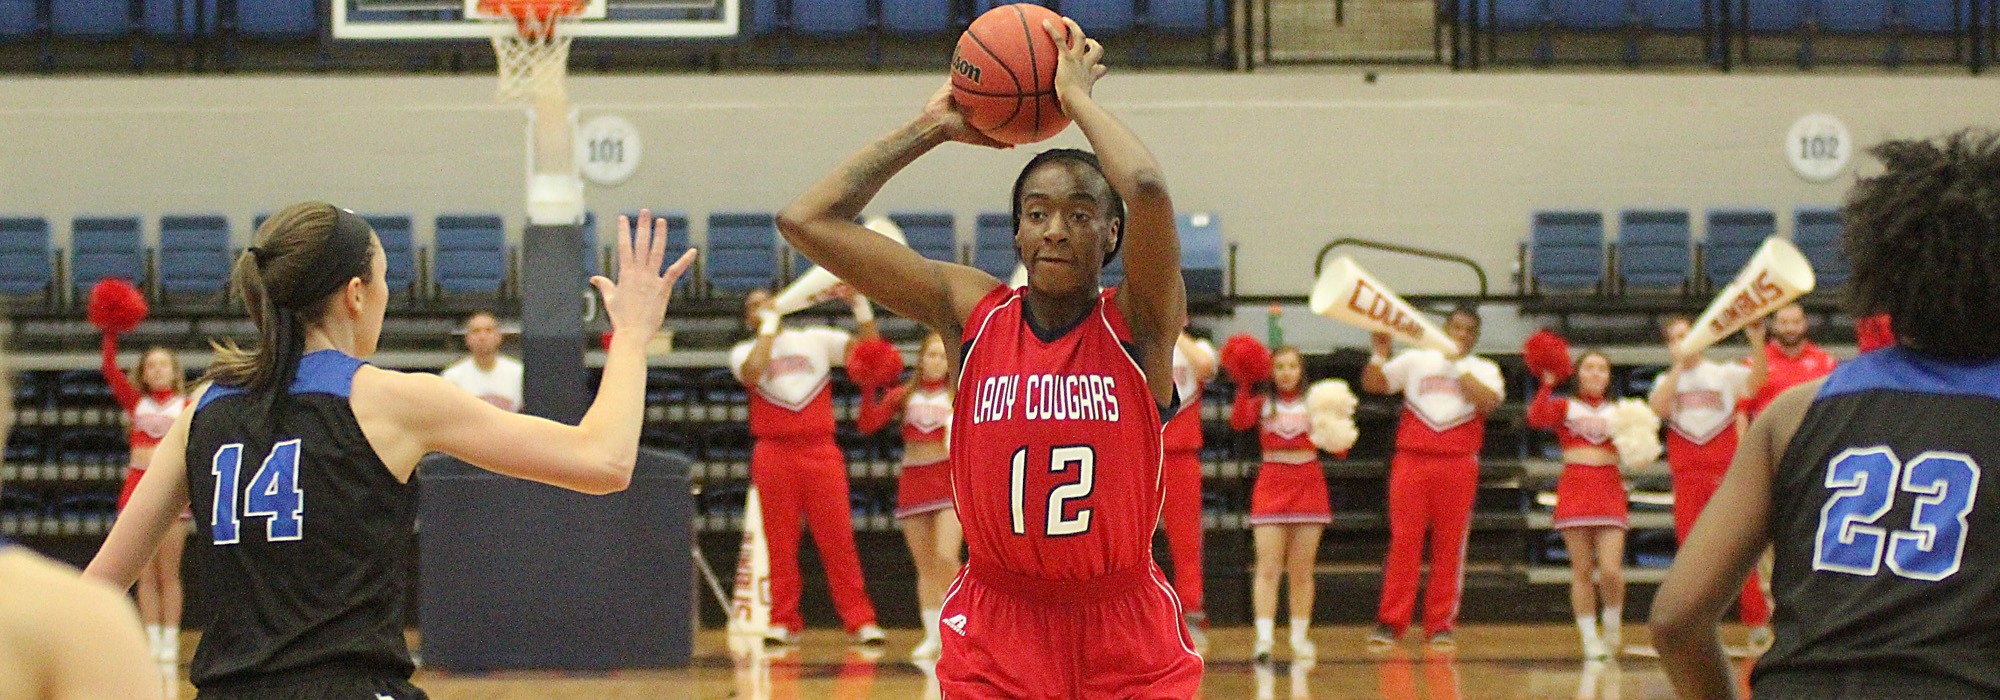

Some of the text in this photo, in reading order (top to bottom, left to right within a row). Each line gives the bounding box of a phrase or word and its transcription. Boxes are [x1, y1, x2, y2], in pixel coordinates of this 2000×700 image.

[588, 138, 624, 163] 101
[1800, 135, 1839, 160] 102
[973, 373, 1120, 425] LADY COUGARS
[211, 438, 304, 545] 14
[1009, 444, 1097, 538] 12
[1812, 445, 1982, 582] 23
